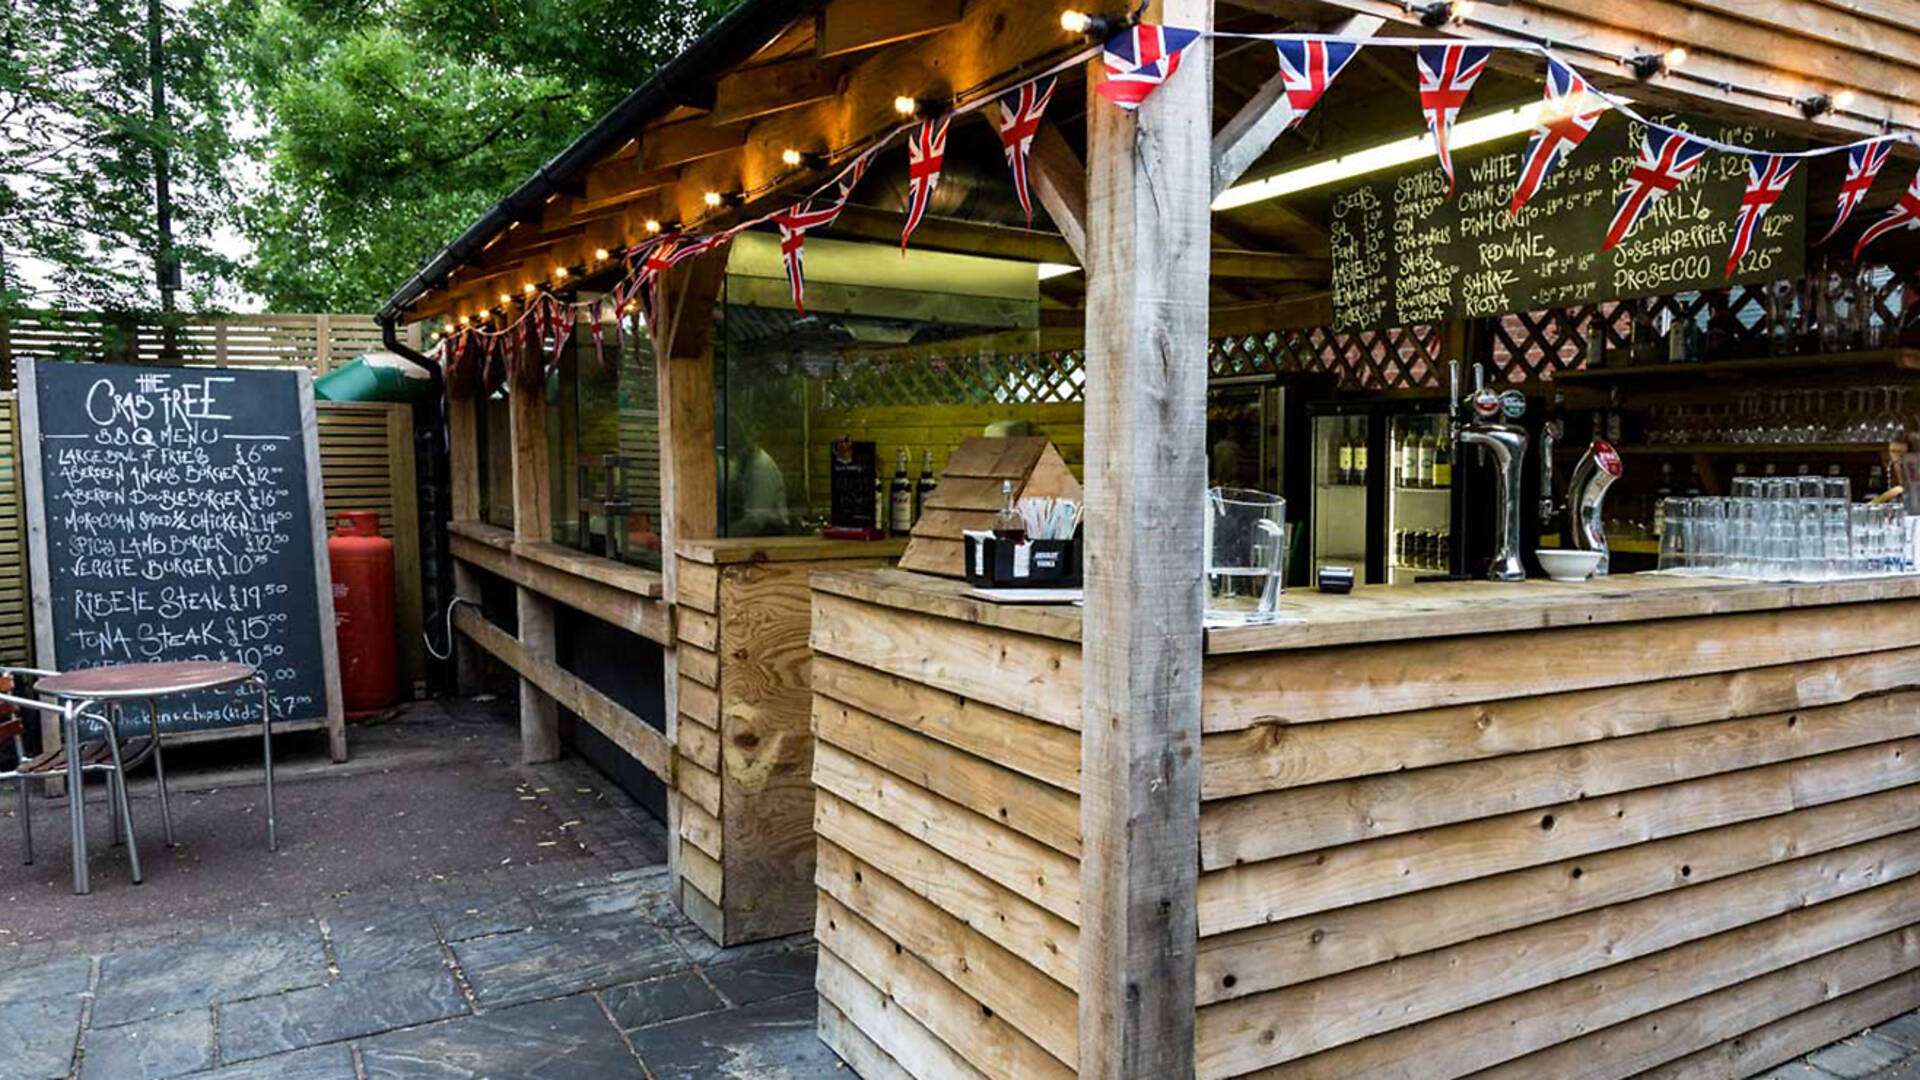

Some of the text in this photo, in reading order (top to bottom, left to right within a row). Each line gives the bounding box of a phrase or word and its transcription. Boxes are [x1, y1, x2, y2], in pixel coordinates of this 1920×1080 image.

[1470, 154, 1517, 183] WHITE
[1478, 243, 1504, 268] RED
[1463, 269, 1520, 297] SHIRAZ
[1613, 255, 1711, 296] PROSECCO
[1466, 293, 1510, 316] RIOJA
[135, 373, 171, 393] THE
[86, 377, 235, 431] CRAB TREE
[160, 420, 218, 449] MENU
[59, 448, 102, 465] LARGE
[161, 447, 210, 466] FRIES
[131, 461, 181, 490] ANGUS
[185, 465, 247, 486] BURGER
[187, 488, 252, 515] BURGER
[64, 508, 135, 536] MOROCCAN
[191, 509, 249, 538] CHICKEN
[68, 535, 116, 557] SPICY
[121, 533, 167, 559] LAMB
[169, 533, 233, 558] BURGER
[71, 555, 138, 578] VEGGIE
[141, 558, 221, 580] BURGER
[158, 585, 227, 619] STEAK
[70, 621, 132, 658] TUNA
[138, 619, 223, 656] STEAK
